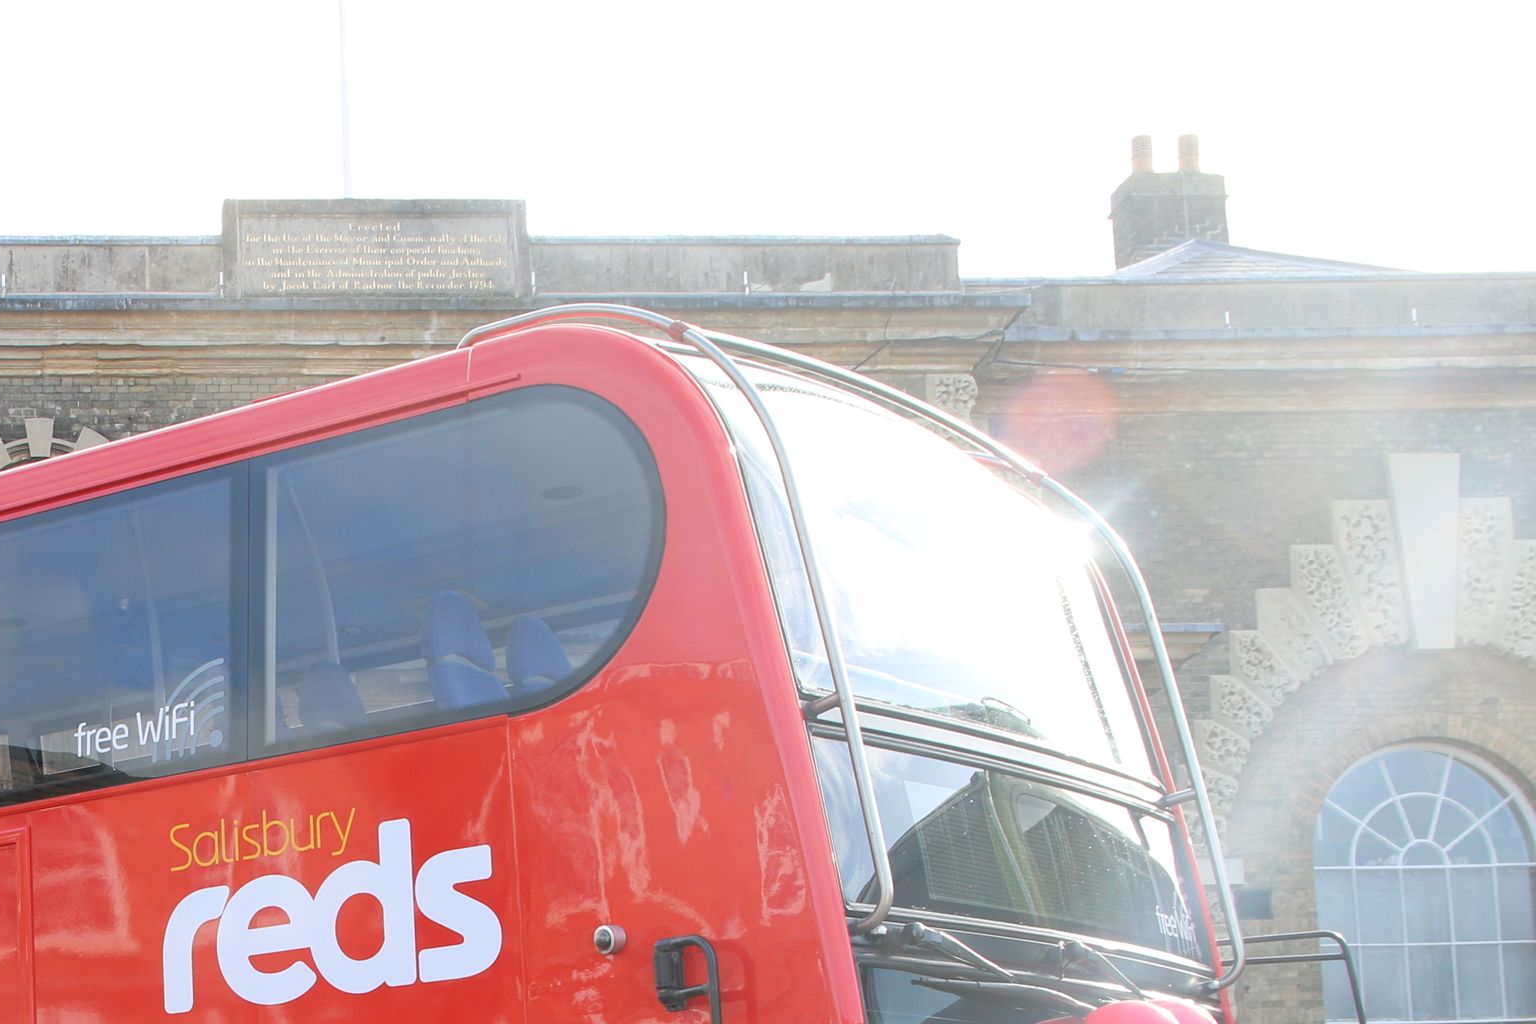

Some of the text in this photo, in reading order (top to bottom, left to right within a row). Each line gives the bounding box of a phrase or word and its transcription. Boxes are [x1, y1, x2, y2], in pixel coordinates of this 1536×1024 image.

[348, 221, 401, 232] Erected
[263, 233, 279, 243] the
[302, 233, 312, 243] of
[315, 233, 331, 243] the
[334, 233, 368, 244] Mayor
[371, 233, 390, 243] and
[287, 245, 303, 254] the
[306, 245, 347, 254] Exercise
[350, 245, 361, 254] of
[363, 245, 387, 254] their
[390, 245, 435, 257] corporate
[257, 257, 273, 266] the
[274, 257, 337, 266] Maintenance
[340, 257, 349, 266] of
[352, 257, 403, 268] Municipal
[406, 257, 436, 266] Order
[440, 257, 459, 266] and
[461, 257, 507, 269] Authority
[271, 269, 291, 278] and
[295, 269, 305, 278] in
[307, 269, 323, 278] the
[326, 269, 402, 278] Administration
[405, 269, 416, 278] of
[417, 269, 448, 281] public
[262, 280, 276, 292] by
[279, 280, 309, 292] Jacob
[312, 280, 336, 290] Earl
[339, 280, 350, 290] of
[353, 280, 394, 290] Radnor
[398, 280, 413, 290] the
[73, 700, 196, 758] free WiFi
[168, 806, 357, 872] Salisbury
[162, 817, 503, 1015] reds
[1155, 904, 1178, 938] free
